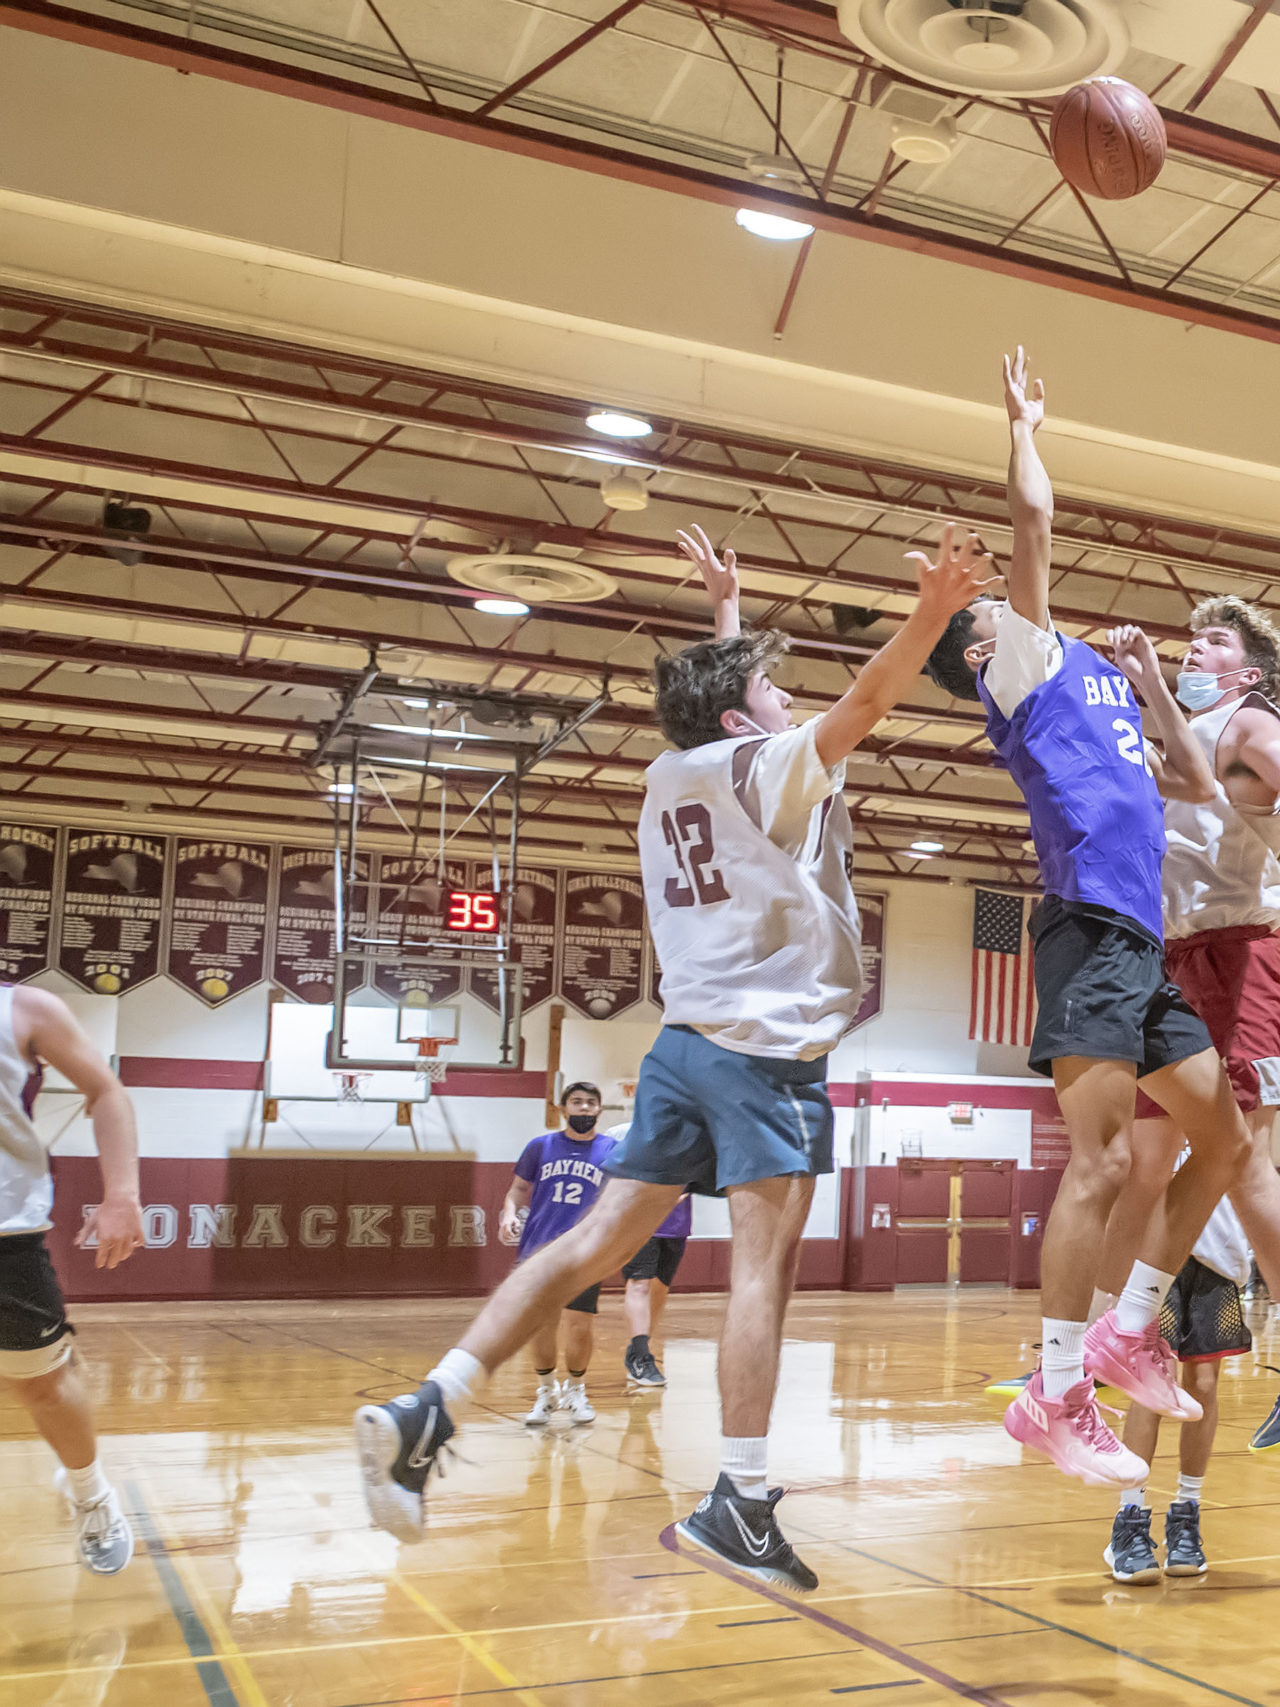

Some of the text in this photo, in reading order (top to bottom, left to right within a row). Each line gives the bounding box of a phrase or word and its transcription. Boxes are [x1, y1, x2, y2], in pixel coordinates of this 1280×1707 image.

[1082, 675, 1130, 708] BAY
[1112, 718, 1147, 770] 2
[1, 825, 54, 852] HOCKEY
[69, 834, 164, 862] SOFTBALL
[178, 843, 268, 870] SOFTBALL
[661, 803, 733, 908] 32
[382, 861, 464, 887] SOFTBLL
[448, 892, 498, 930] 35
[540, 1159, 604, 1188] BAYMEN
[552, 1181, 584, 1205] 12
